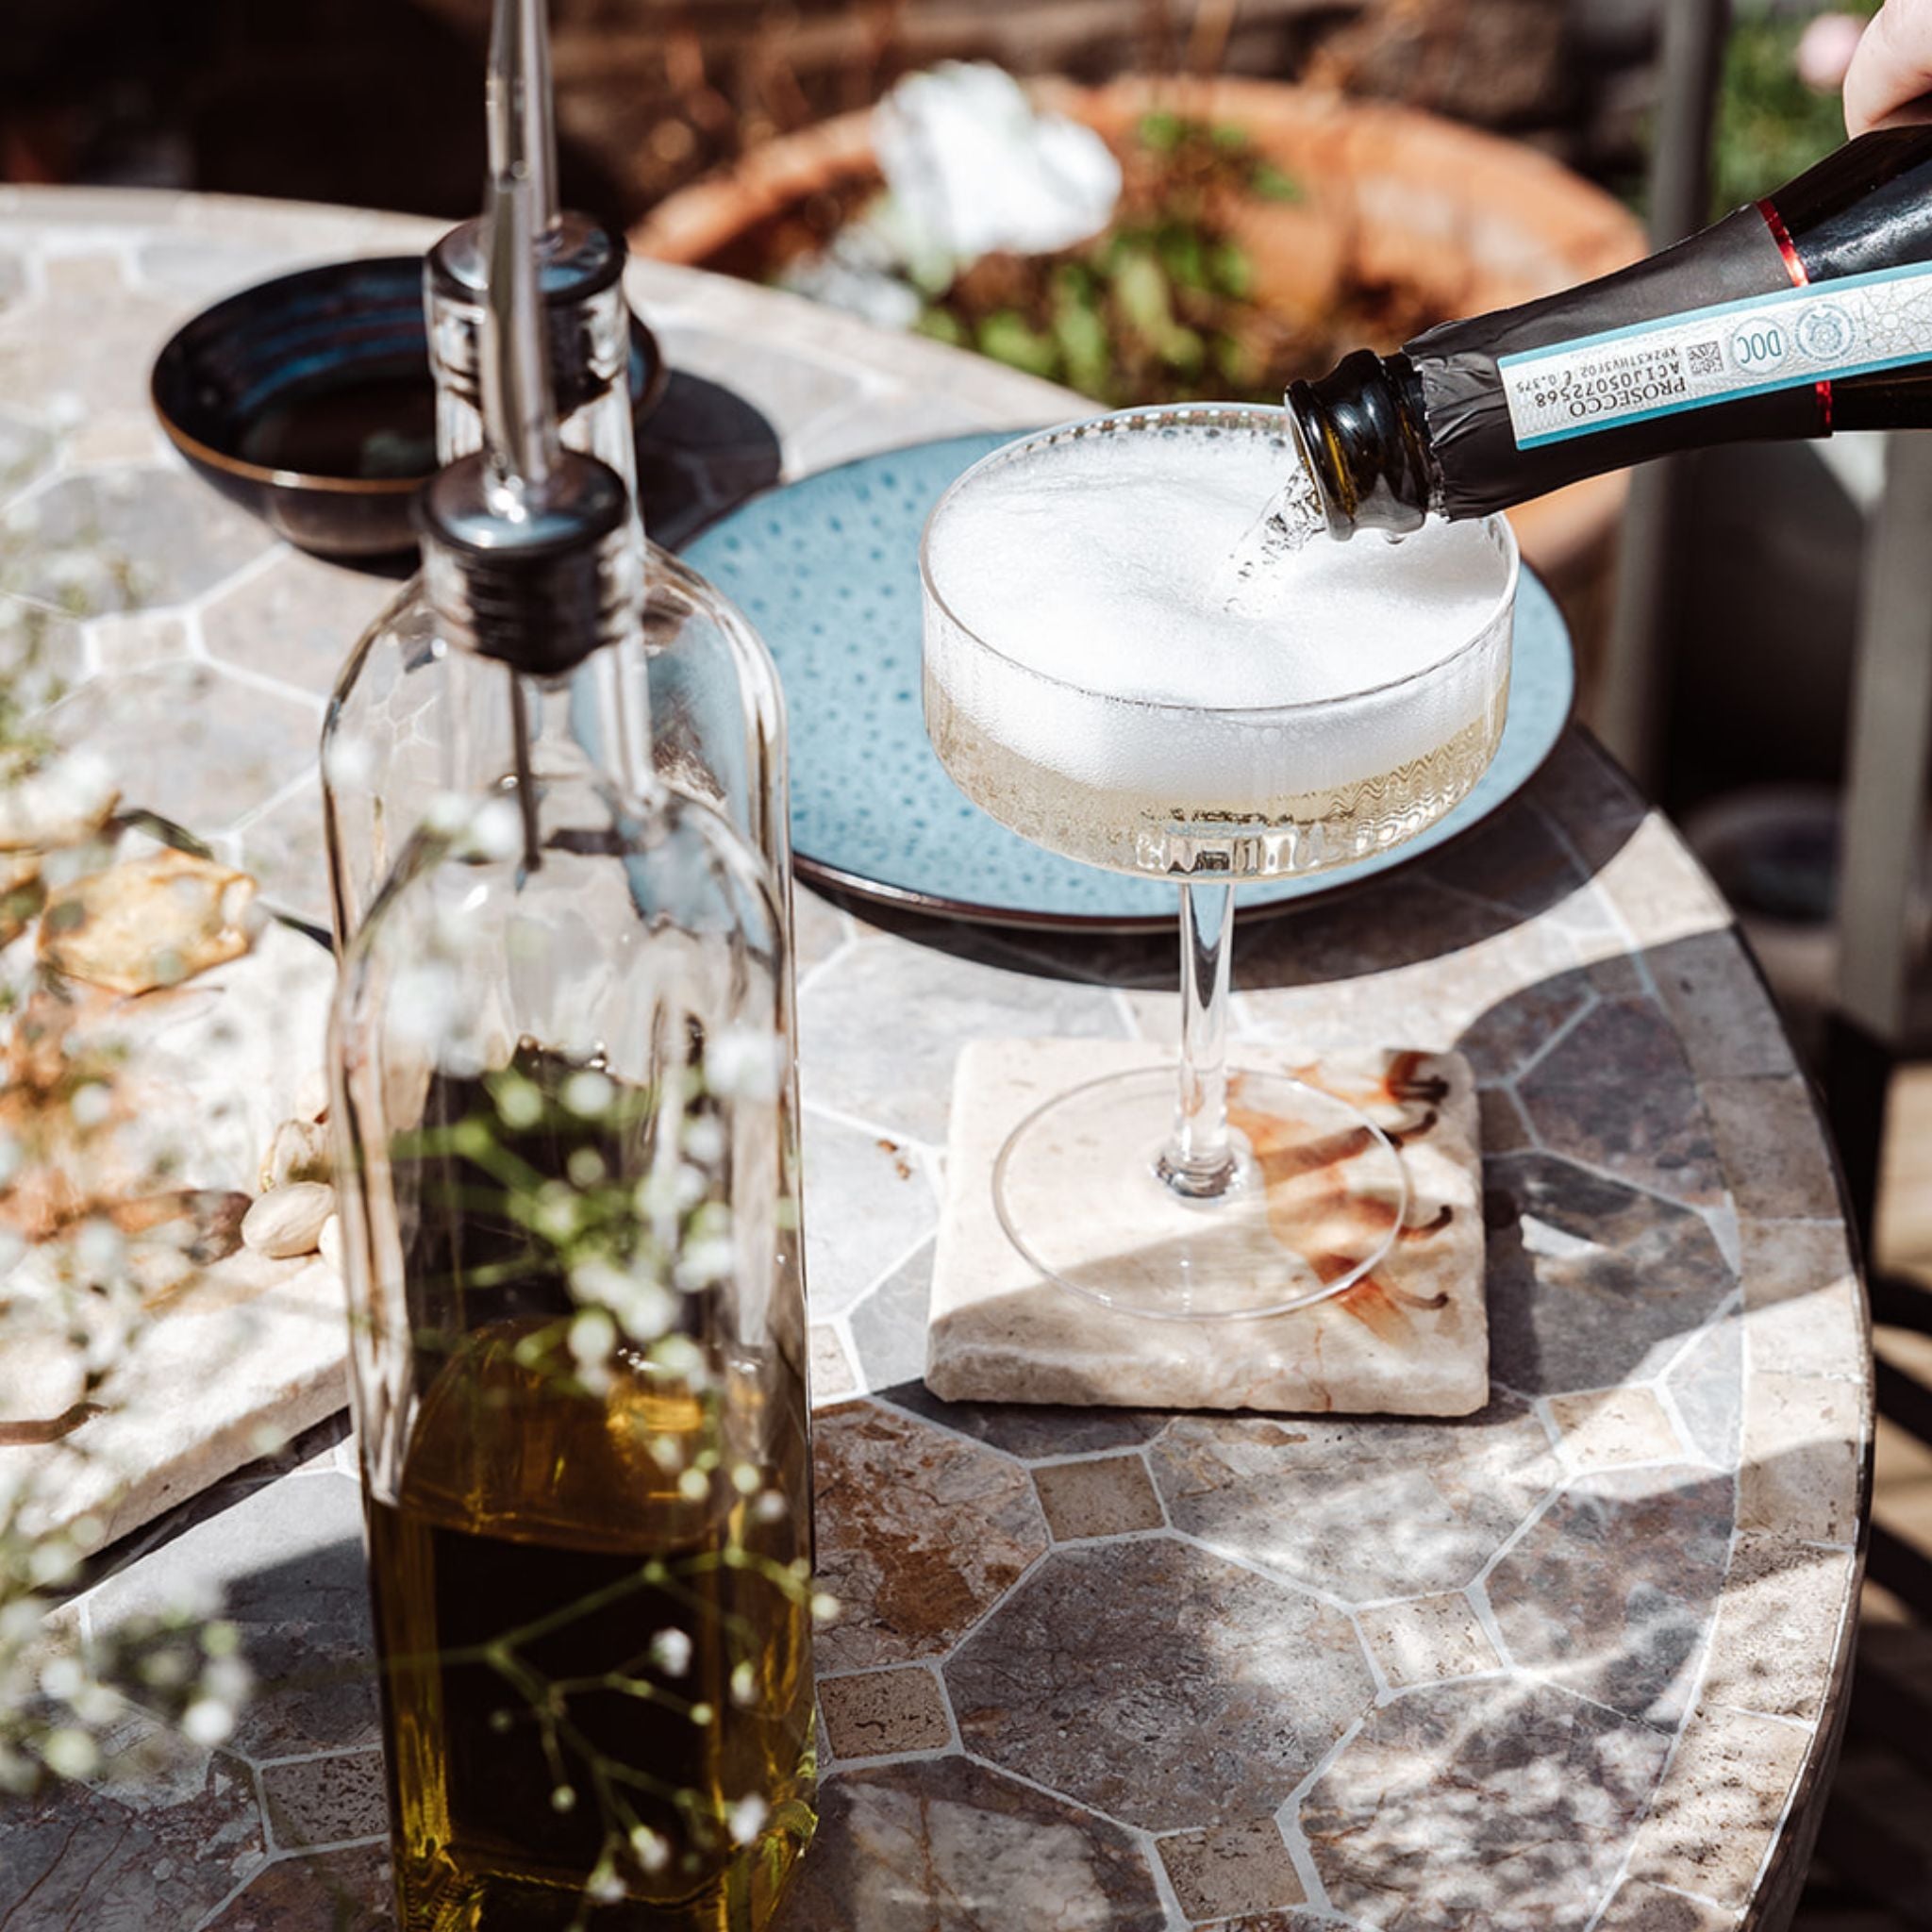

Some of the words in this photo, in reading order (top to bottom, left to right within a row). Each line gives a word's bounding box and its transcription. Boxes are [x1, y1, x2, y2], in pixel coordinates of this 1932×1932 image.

[1737, 329, 1782, 364] DOC
[1516, 375, 1557, 393] 0.375
[1570, 376, 1686, 418] PROSECCO
